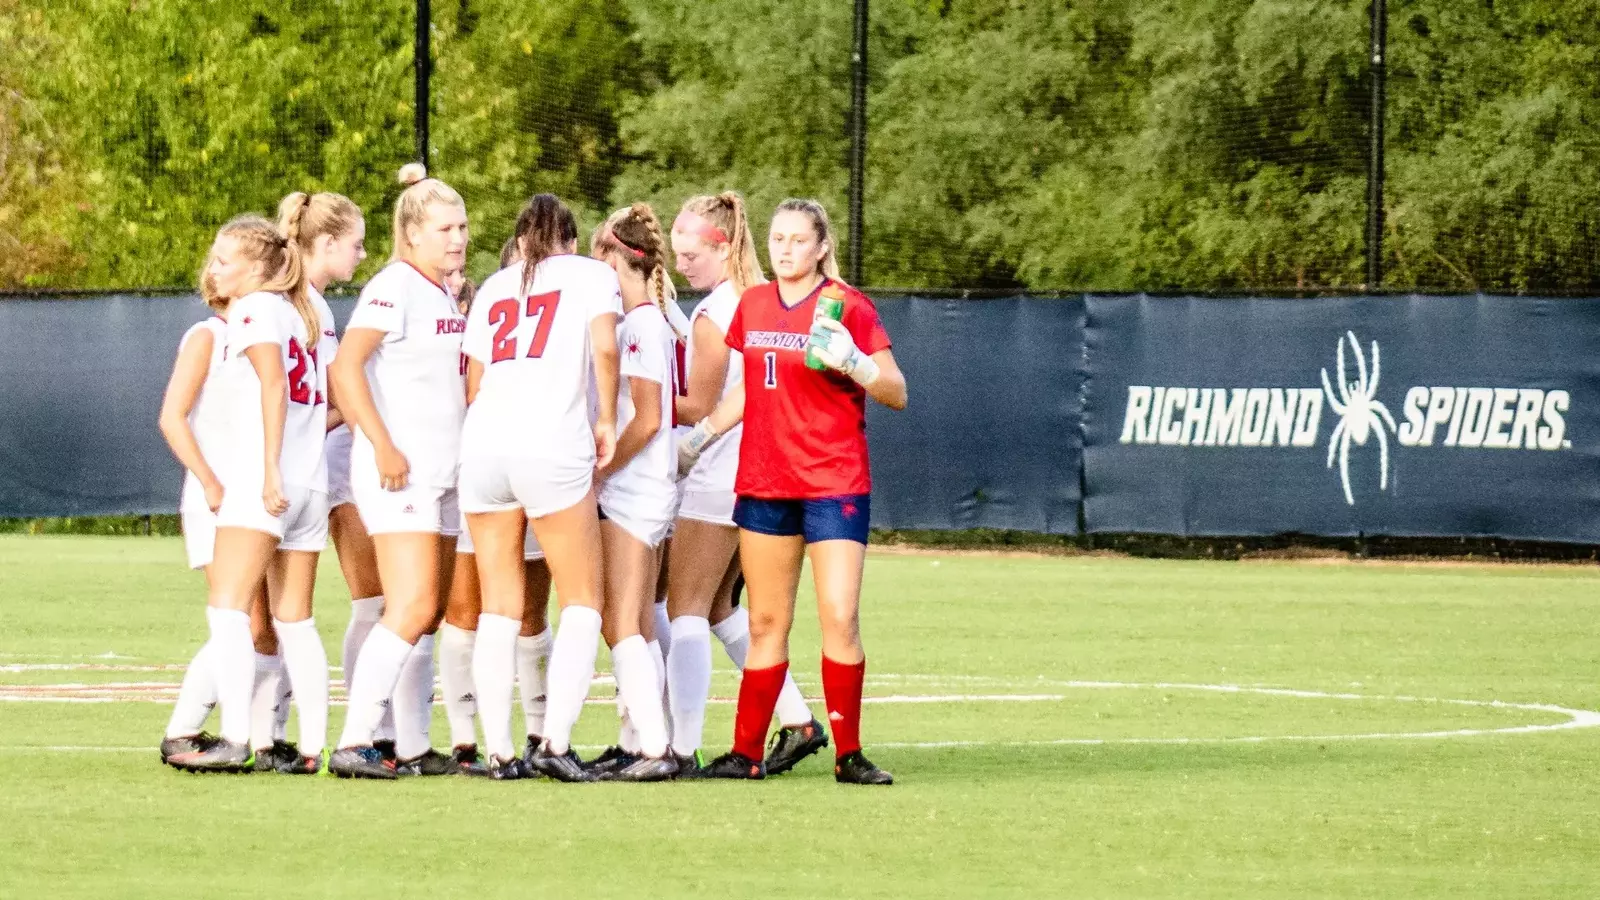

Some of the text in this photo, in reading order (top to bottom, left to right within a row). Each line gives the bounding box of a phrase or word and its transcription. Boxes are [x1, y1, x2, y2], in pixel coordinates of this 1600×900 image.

[488, 289, 561, 364] 27
[764, 351, 777, 389] 1
[1120, 385, 1323, 447] RICHMOND
